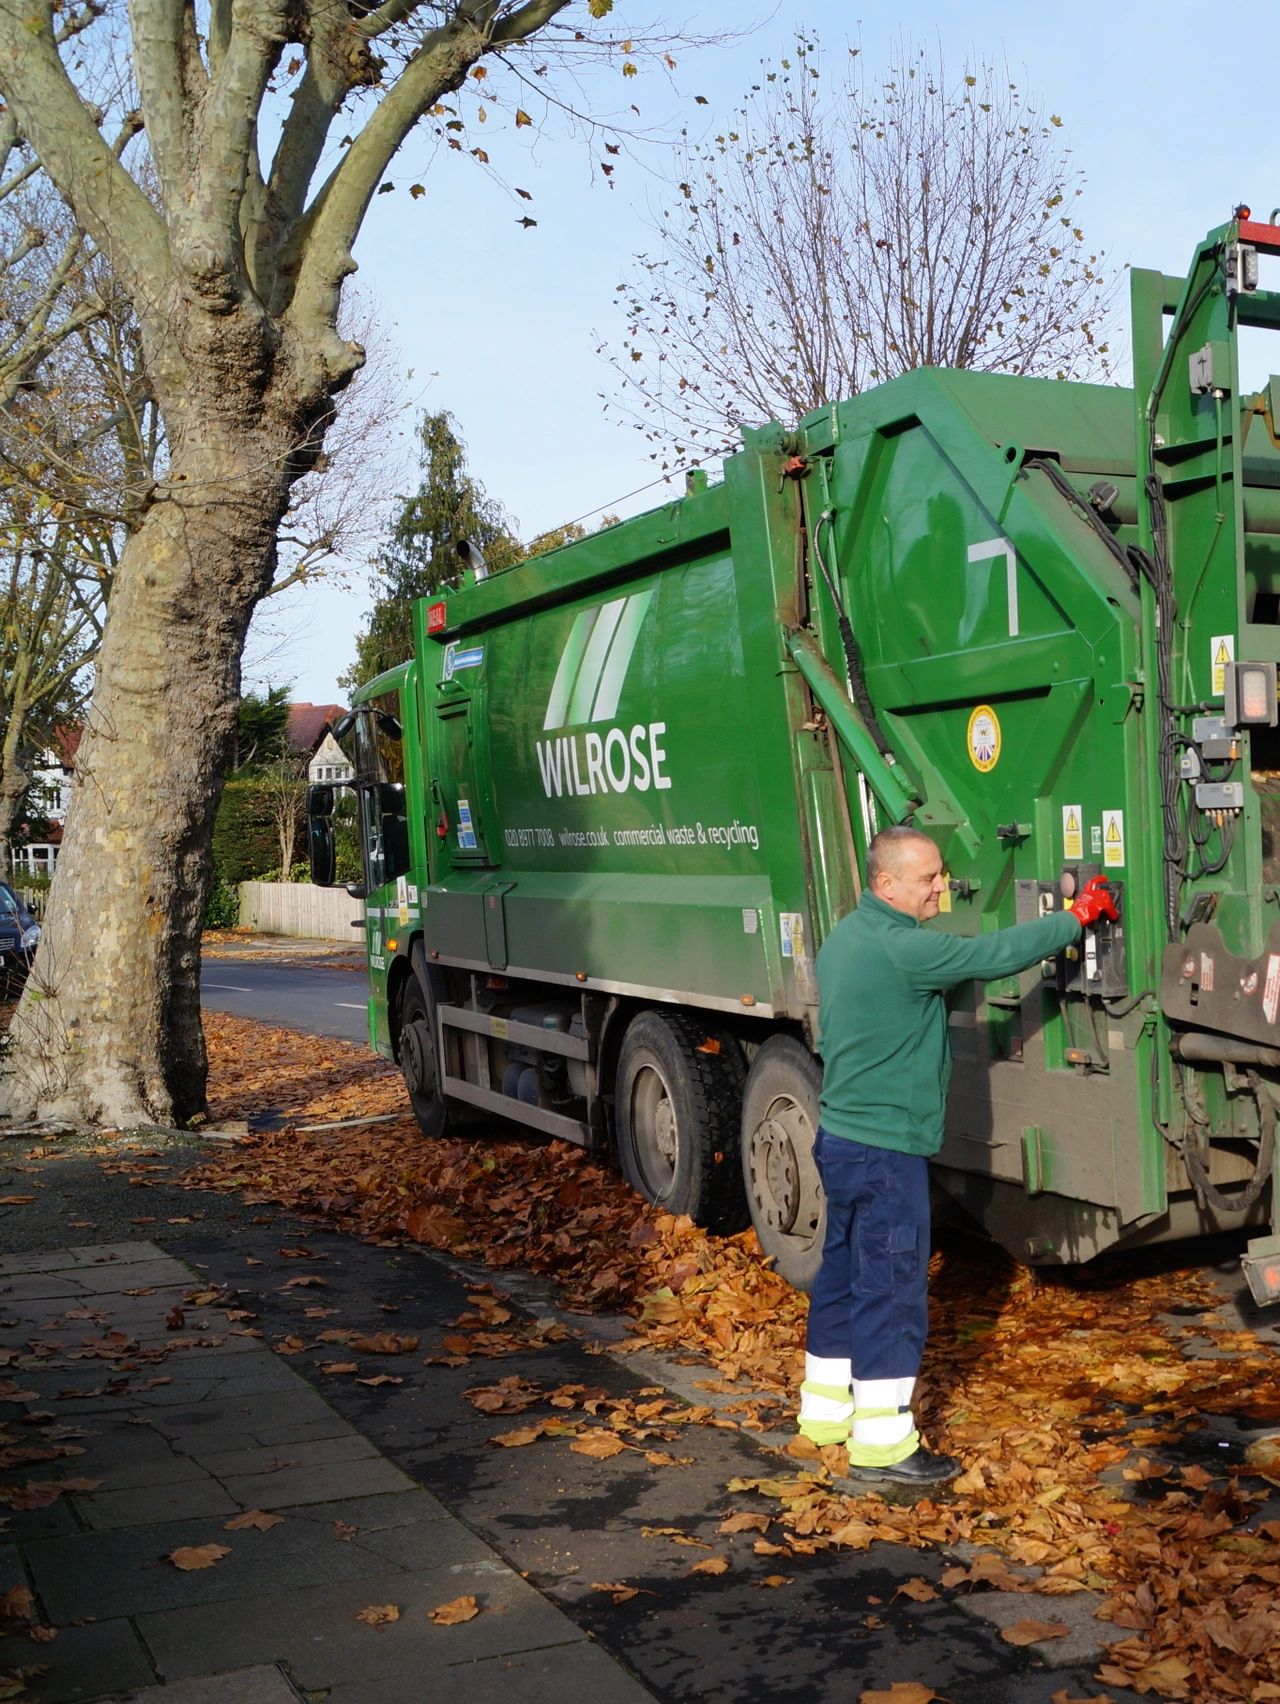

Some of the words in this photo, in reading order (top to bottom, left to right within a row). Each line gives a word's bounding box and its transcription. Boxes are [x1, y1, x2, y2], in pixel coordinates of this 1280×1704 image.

[536, 721, 672, 798] WILROSE
[504, 828, 518, 847] 020
[518, 828, 535, 847] 8977
[535, 827, 555, 847] 7008
[559, 825, 610, 847] wilrose.co.uk
[613, 823, 666, 846] commercial
[666, 825, 696, 846] waste
[696, 821, 708, 845] &
[708, 819, 760, 850] recycling
